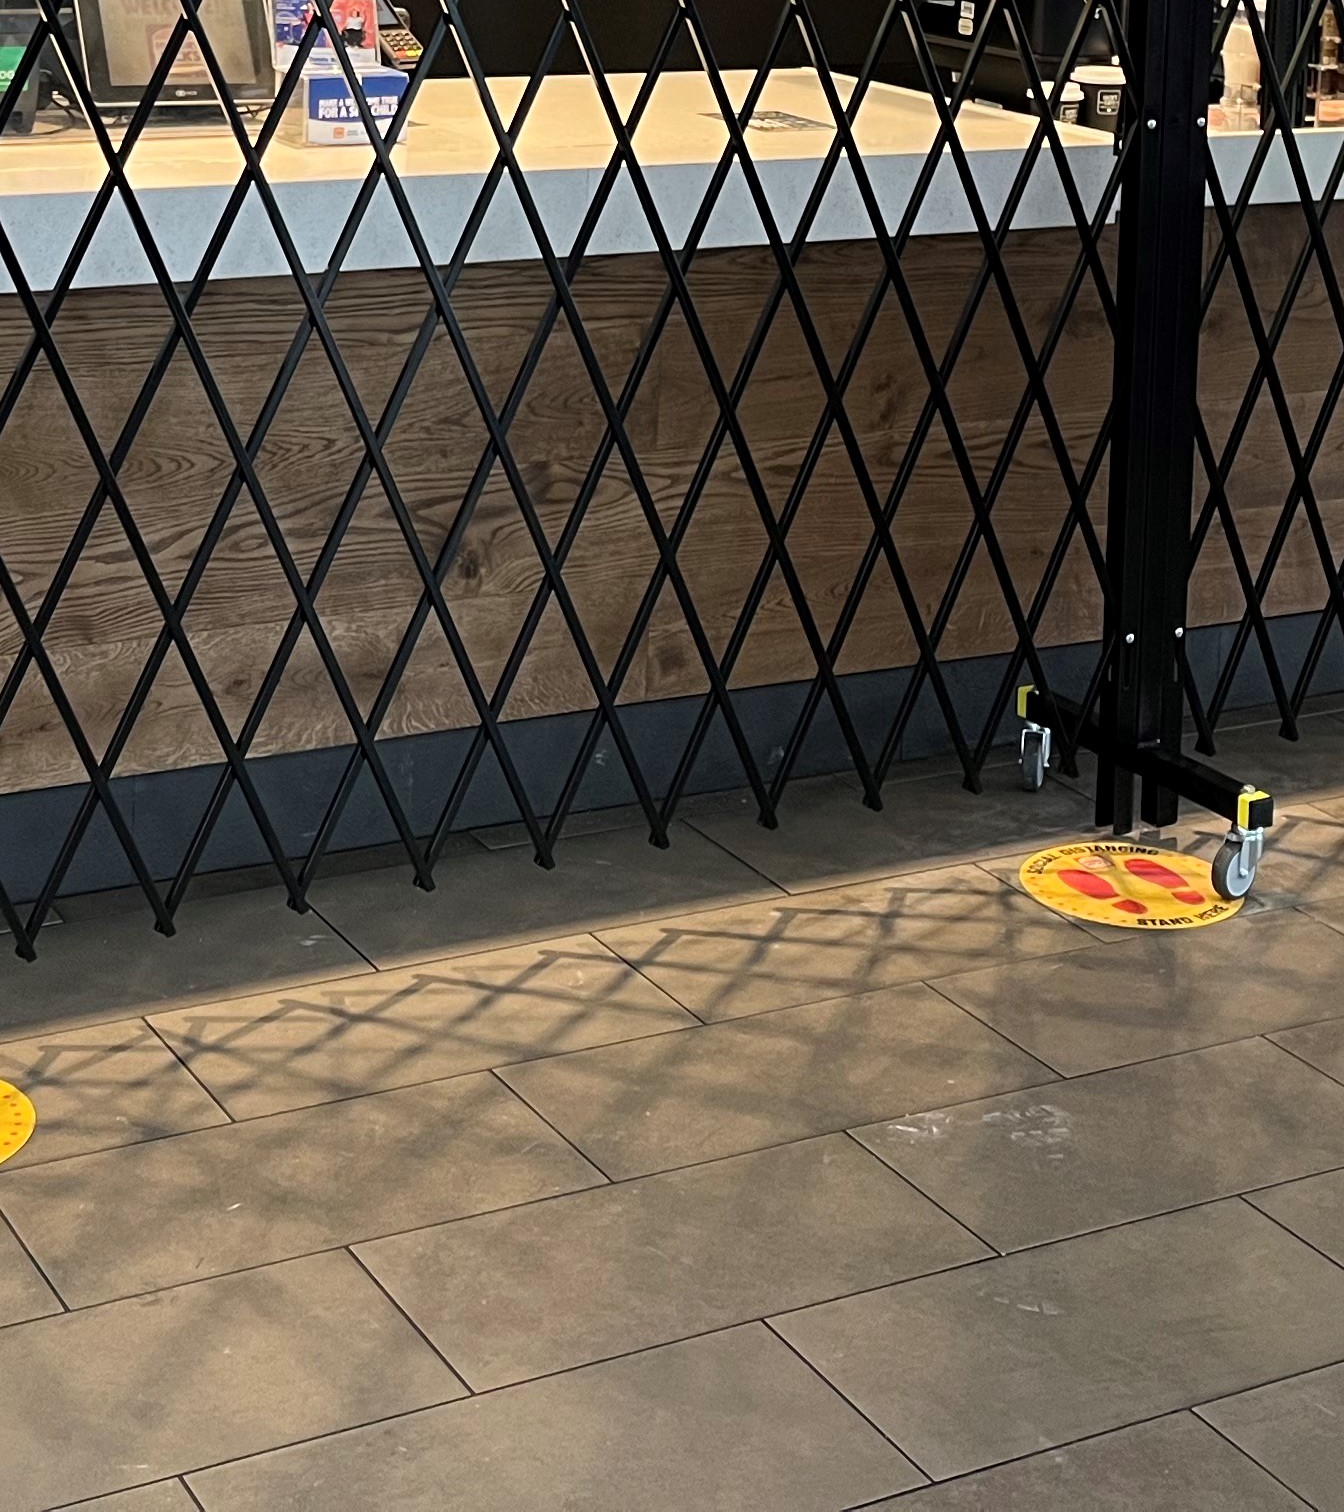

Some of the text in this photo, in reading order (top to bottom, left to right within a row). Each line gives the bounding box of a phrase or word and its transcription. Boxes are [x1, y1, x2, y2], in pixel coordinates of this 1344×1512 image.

[319, 106, 339, 119] FOR
[340, 106, 348, 118] A
[1137, 918, 1193, 927] STAND
